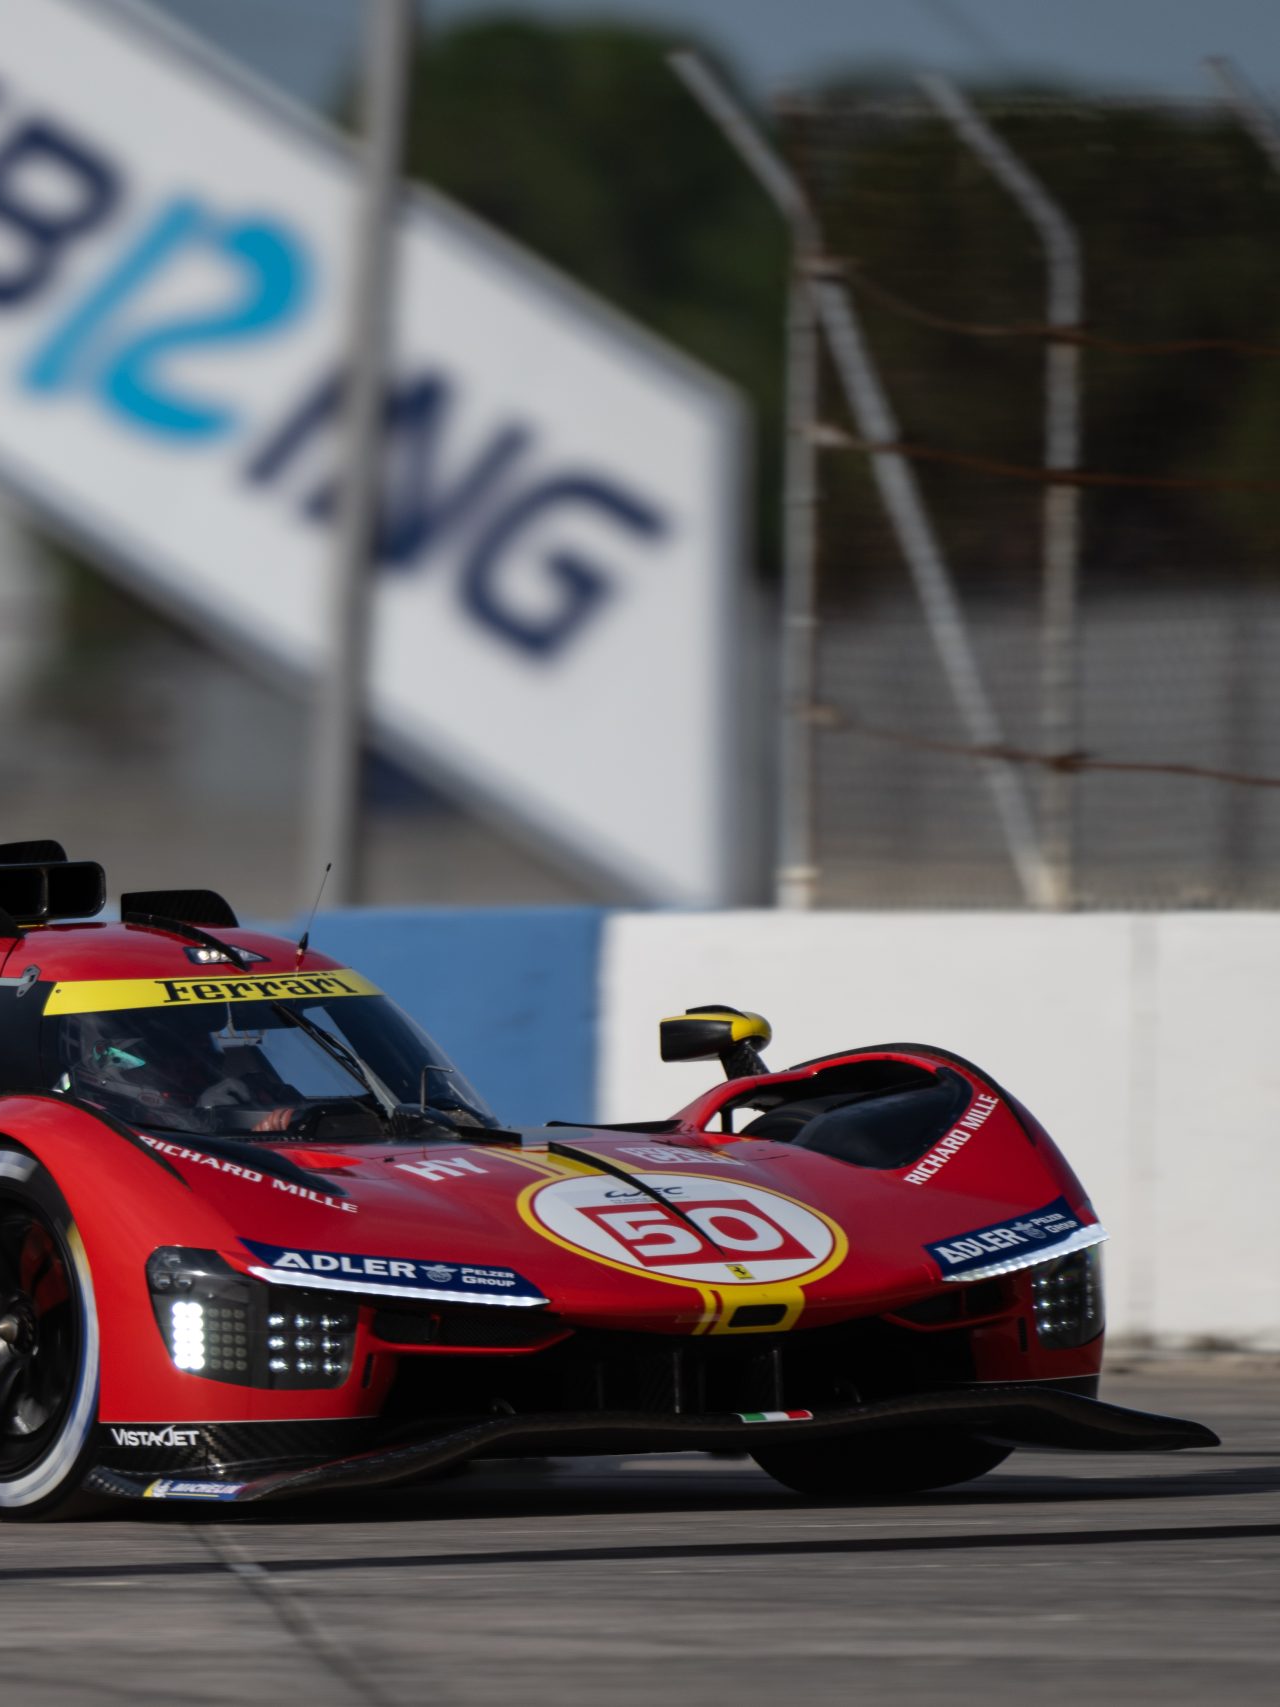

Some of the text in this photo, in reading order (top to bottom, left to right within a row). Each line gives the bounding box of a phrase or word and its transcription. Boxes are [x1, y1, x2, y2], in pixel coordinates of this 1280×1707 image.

[154, 970, 359, 1004] Ferrari
[903, 1093, 1000, 1186] RICHARD MILLE
[137, 1134, 359, 1214] RICHARD MILLE
[393, 1157, 490, 1182] HY
[1030, 1203, 1066, 1226] PELZER
[1044, 1210, 1079, 1234] GROUP
[596, 1206, 785, 1257] 50
[934, 1228, 1029, 1265] ADLER
[273, 1252, 417, 1279] ADLER
[461, 1266, 515, 1279] PELZER
[461, 1276, 517, 1288] GROUP
